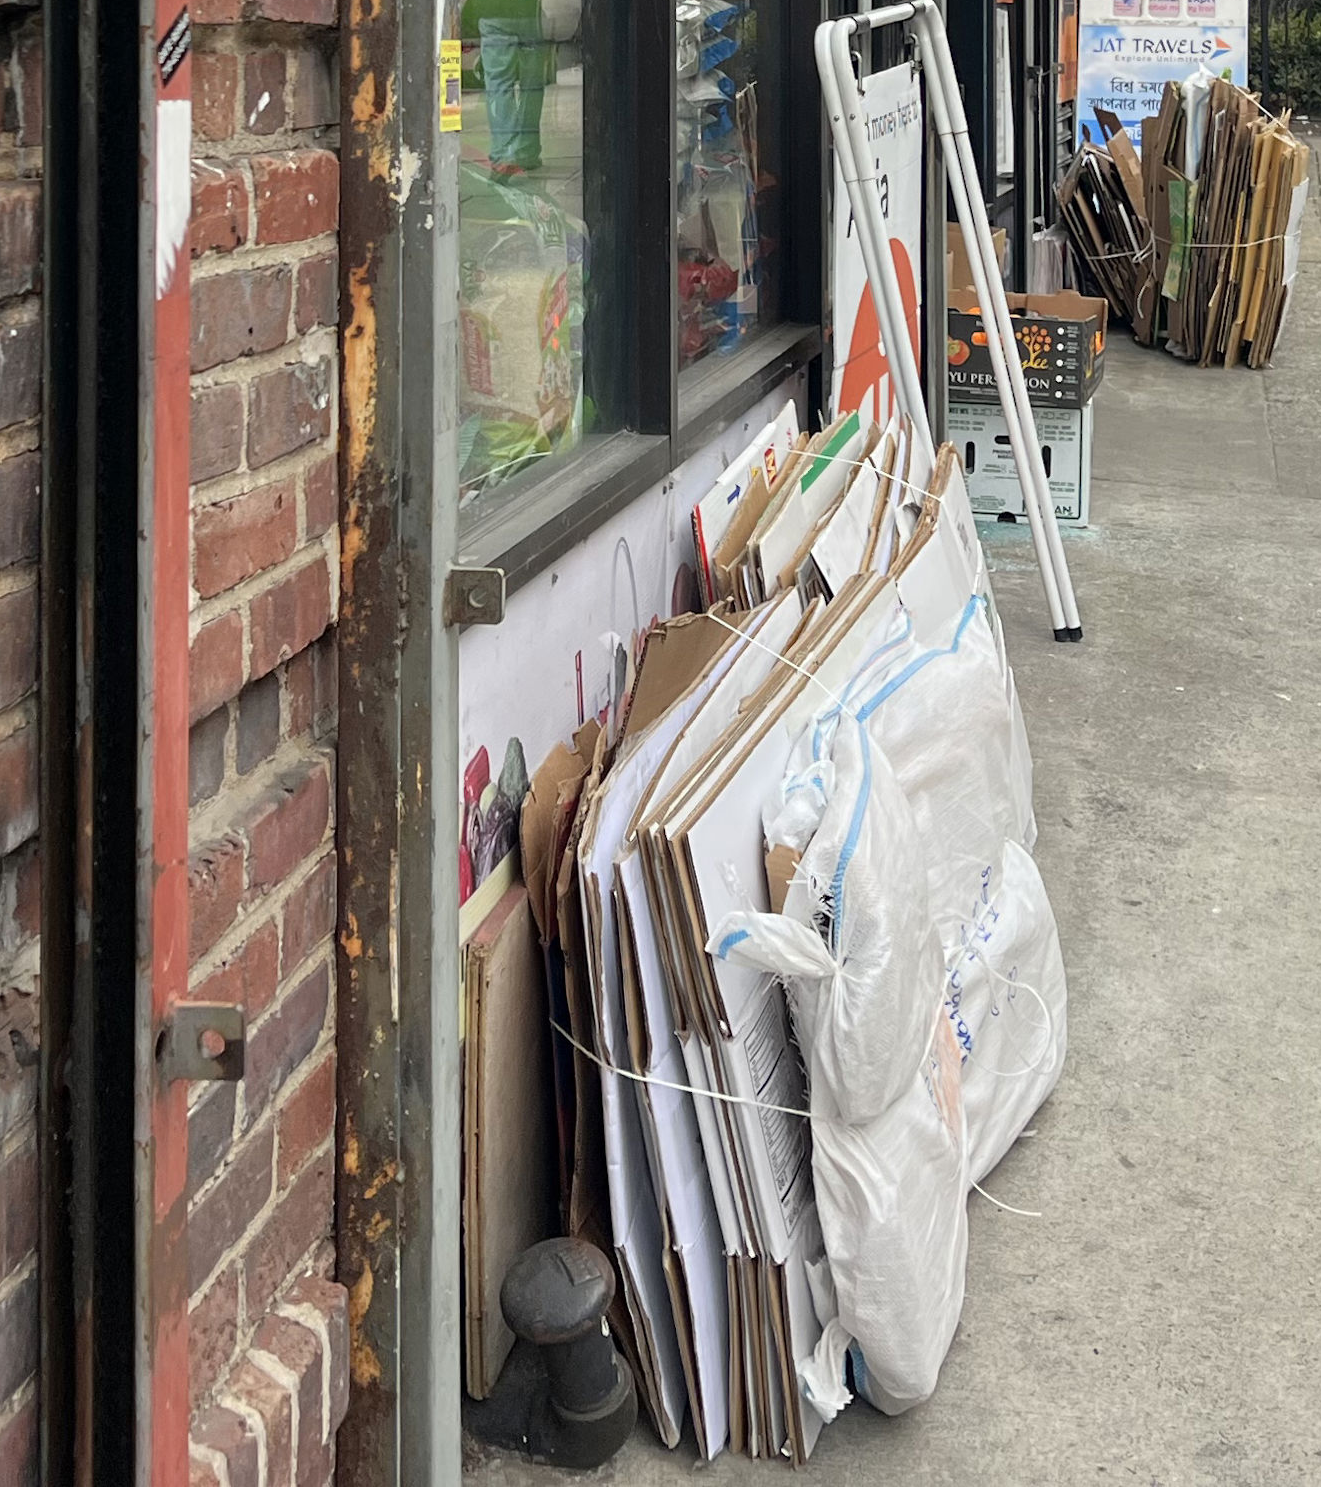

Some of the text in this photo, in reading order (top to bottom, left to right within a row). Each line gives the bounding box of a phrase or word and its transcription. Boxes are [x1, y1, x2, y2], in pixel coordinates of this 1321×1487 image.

[1093, 37, 1212, 55] JAT TRAVELS
[1114, 54, 1206, 64] Explore Unlimited
